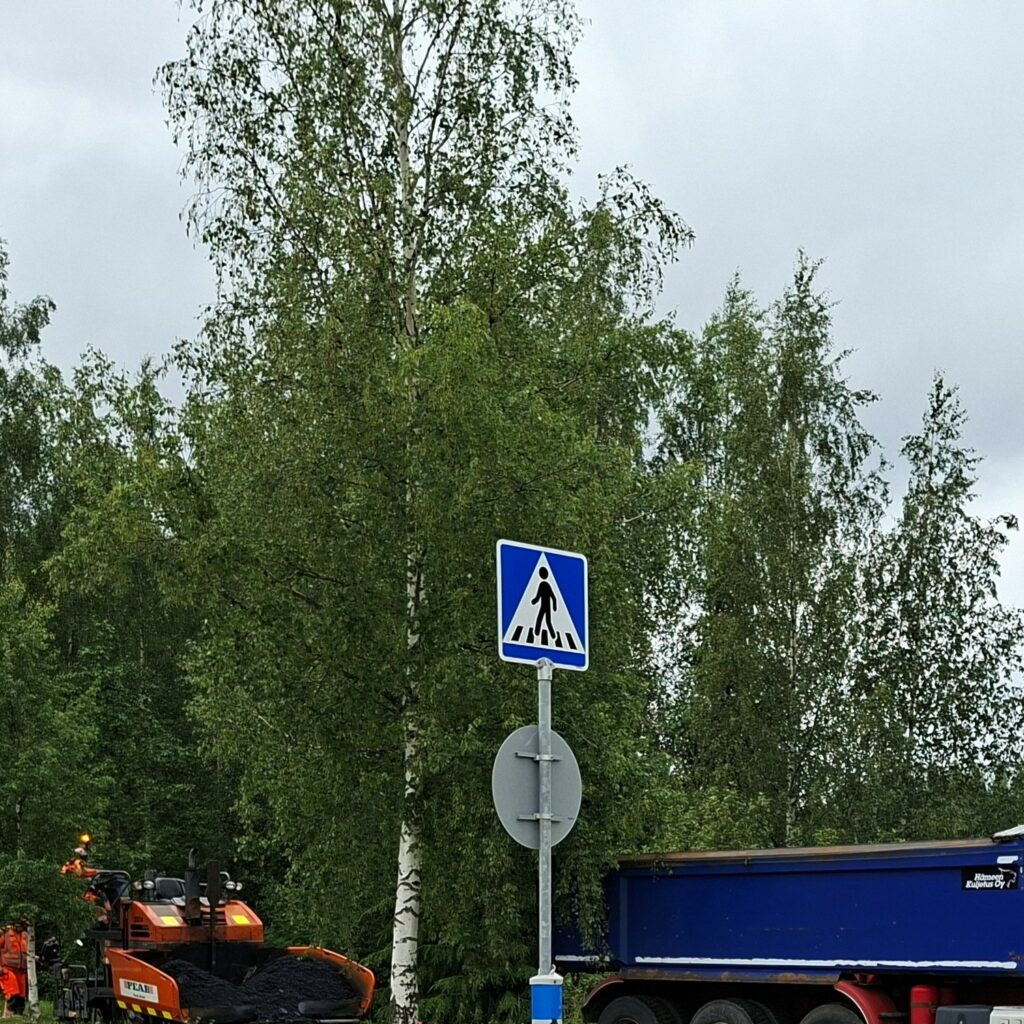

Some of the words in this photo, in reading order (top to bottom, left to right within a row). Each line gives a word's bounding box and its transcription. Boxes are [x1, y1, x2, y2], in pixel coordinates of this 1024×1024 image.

[965, 880, 994, 889] Kuljetus
[994, 880, 1006, 889] Oy
[127, 981, 150, 994] PEAB
